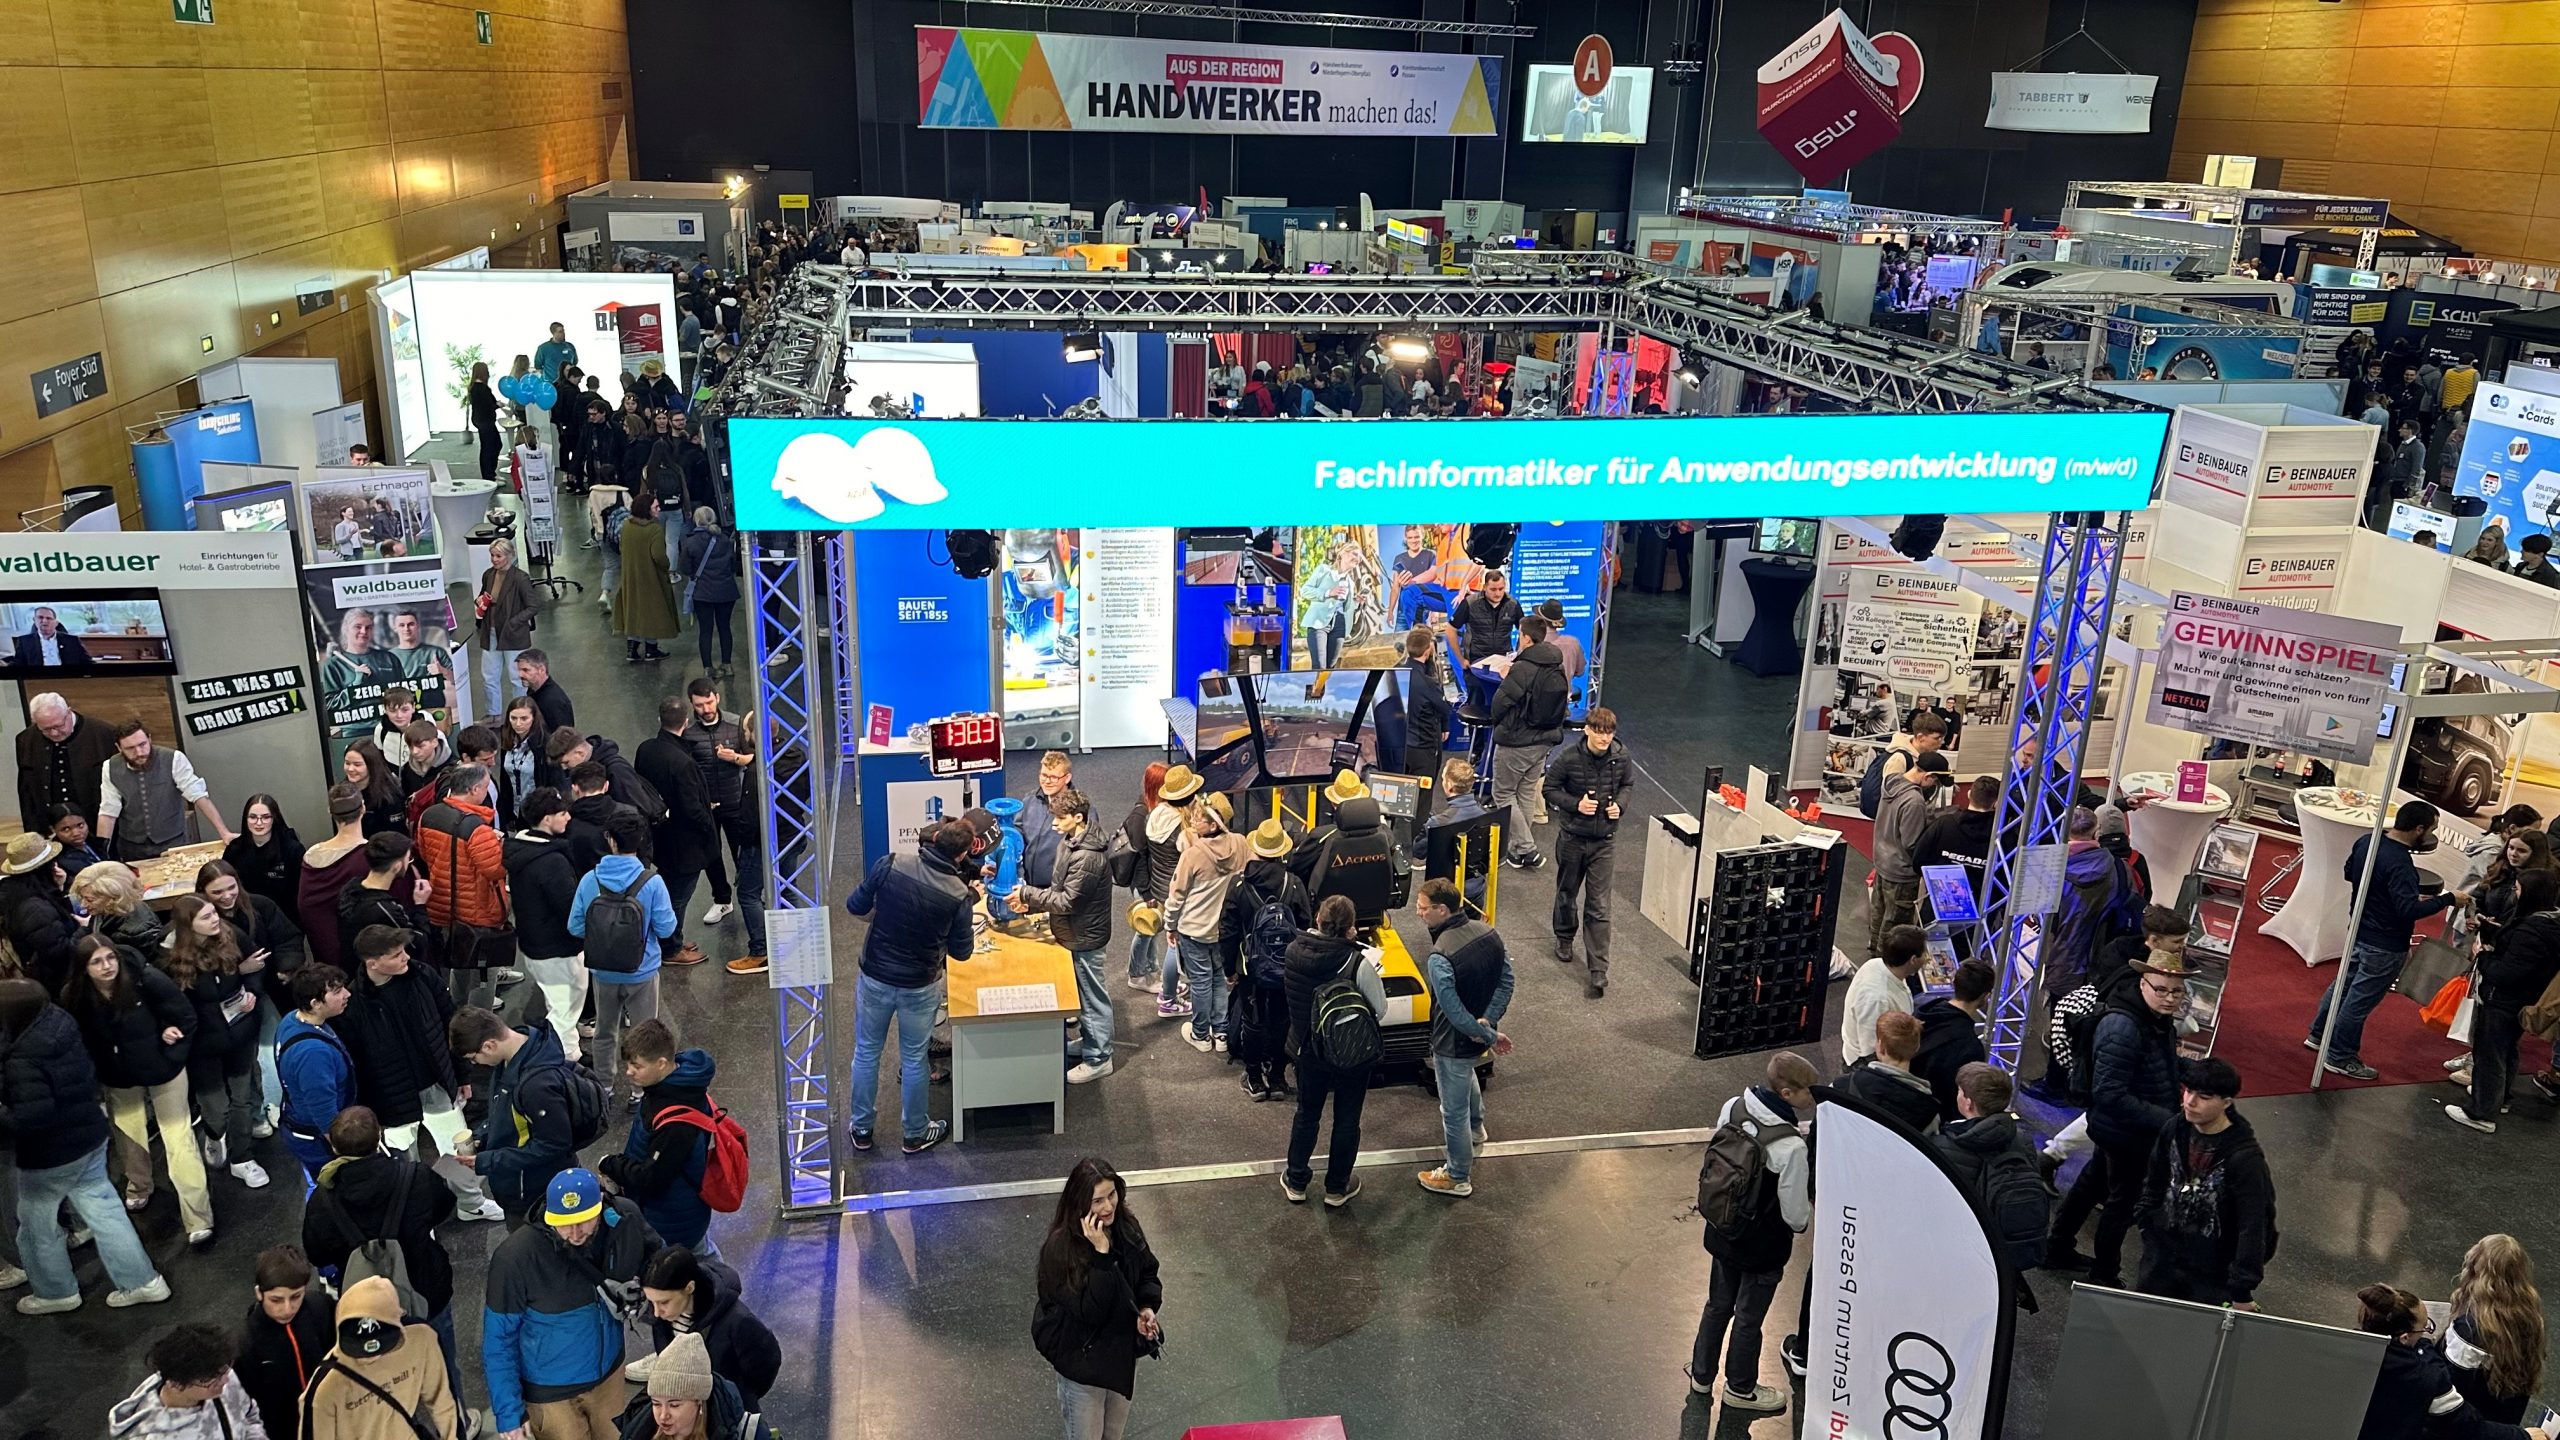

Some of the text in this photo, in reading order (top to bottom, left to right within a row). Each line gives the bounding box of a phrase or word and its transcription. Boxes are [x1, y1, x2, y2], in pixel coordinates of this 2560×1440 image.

[1169, 59, 1280, 78] AUS DER REGION
[1583, 49, 1601, 82] A
[1088, 82, 1437, 124] HANDWERKER machen das!
[2018, 92, 2075, 103] TABBERT
[2315, 204, 2374, 214] FÜR JEDES TALENT
[2314, 213, 2381, 222] DIE RICHTIGE CHANCE
[2314, 292, 2330, 300] WIR
[2331, 293, 2349, 301] SIND
[2313, 301, 2349, 309] RICHTIGE
[2311, 308, 2327, 317] FÜR
[2328, 309, 2349, 317] DICH.
[55, 357, 98, 388] Foyer Süd
[72, 382, 89, 402] WC
[2525, 411, 2555, 426] Cards
[217, 424, 242, 436] Solutions
[1314, 451, 2139, 490] Fachinformatiker für Anwendungsentwicklung (m/w/d)
[2197, 452, 2249, 479] BEINBAUER
[2194, 467, 2230, 485] AUTOMOTIVE
[2290, 467, 2357, 481] BEINBAUER
[361, 479, 423, 493] technagon
[2288, 482, 2334, 492] AUTOMOTIVE
[201, 551, 279, 561] Einrichtungen für
[179, 562, 281, 572] Hotel- & Gastrobetriebe
[2270, 559, 2336, 572] BEINBAUER
[1898, 578, 1958, 592] BEINBAUER
[2268, 574, 2313, 583] AUTOMOTIVE
[342, 576, 438, 596] waldbauer
[1897, 590, 1938, 599] AUTOMOTIVE
[898, 600, 936, 611] BAUEN
[2200, 598, 2260, 616] BEINBAUER
[898, 610, 948, 621] SEIT 1855
[1865, 616, 1894, 625] Kollegen
[2200, 608, 2240, 621] AUTOMOTIVE
[1855, 629, 1881, 638] Karriere
[1923, 623, 1970, 634] Sicherheit
[1926, 639, 1961, 650] Company
[2174, 620, 2385, 677] GEWINNSPIEL
[1893, 658, 1944, 669] Willkommen
[2198, 650, 2351, 684] Wie gut kannst du schätzen?
[1911, 666, 1936, 675] Team!
[190, 670, 296, 700] ZEIG, WAS DU
[353, 684, 385, 701] ZEIG,
[420, 677, 439, 691] DU
[2173, 662, 2371, 706] Mach mit und gewinne einen von fünf
[2164, 692, 2208, 709] NETFLIX
[2234, 685, 2300, 705] Gutscheinen
[193, 690, 300, 733] DRAUF HAST!
[334, 708, 376, 725] DRAUF
[2247, 708, 2274, 718] amazon
[898, 828, 923, 838] PFA
[1345, 853, 1387, 866] Acreos
